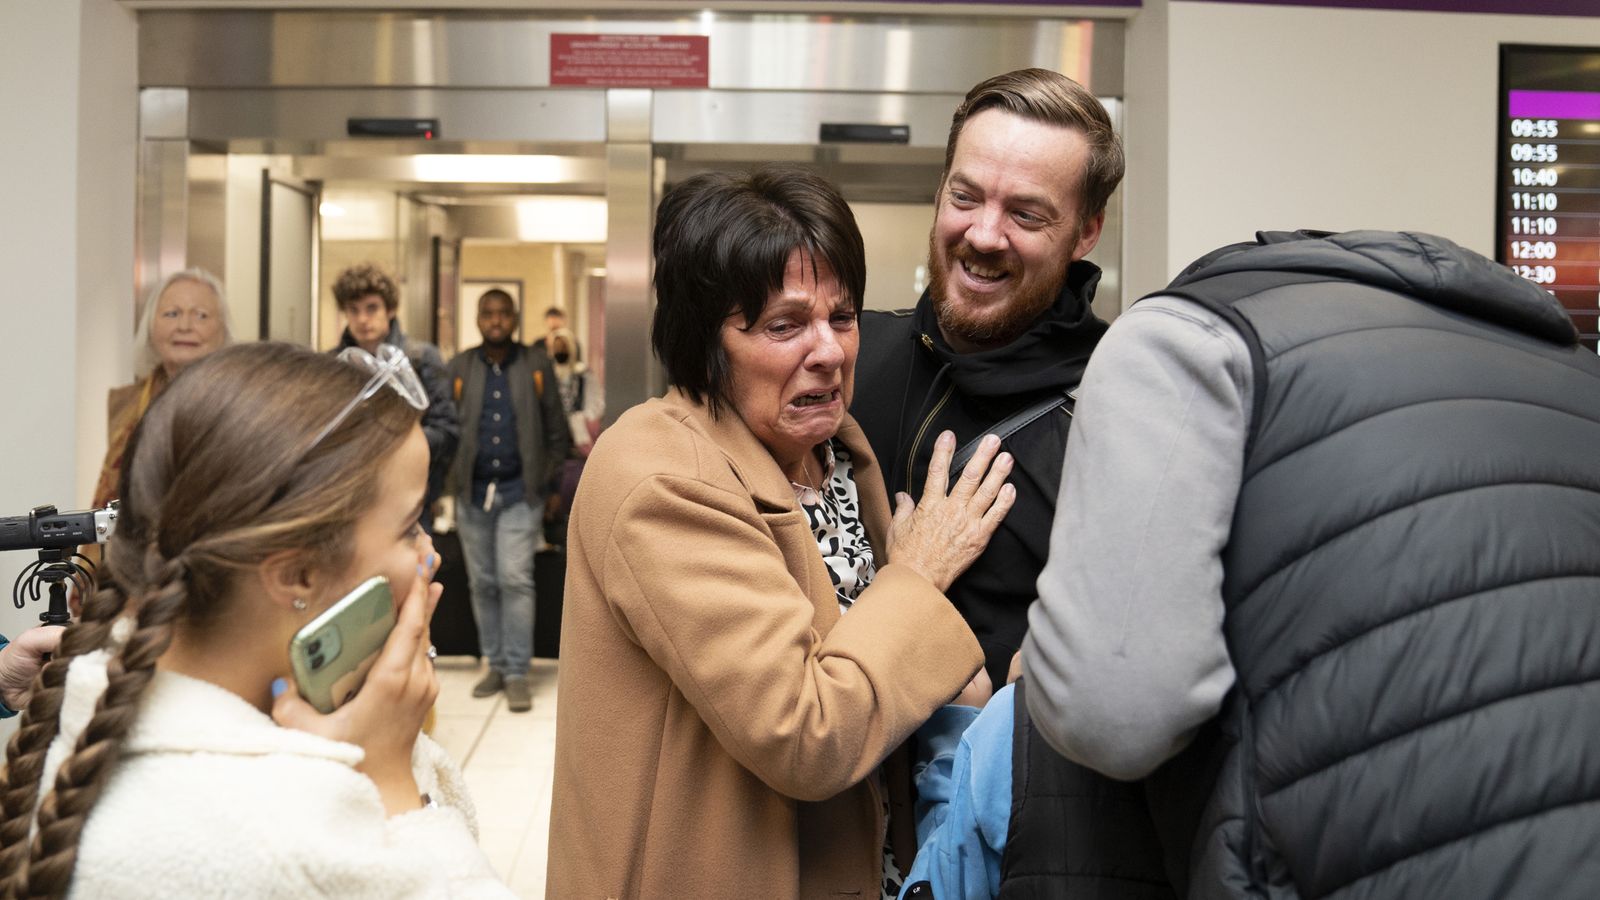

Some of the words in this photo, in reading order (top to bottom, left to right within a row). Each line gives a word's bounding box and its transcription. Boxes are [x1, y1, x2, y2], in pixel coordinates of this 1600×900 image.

[1511, 119, 1558, 137] 09:55
[1511, 143, 1558, 162] 09:55
[1512, 168, 1558, 186] 10:40
[1511, 192, 1558, 211] 11:10
[1511, 217, 1557, 235] 11:10
[1511, 241, 1557, 259] 12:00
